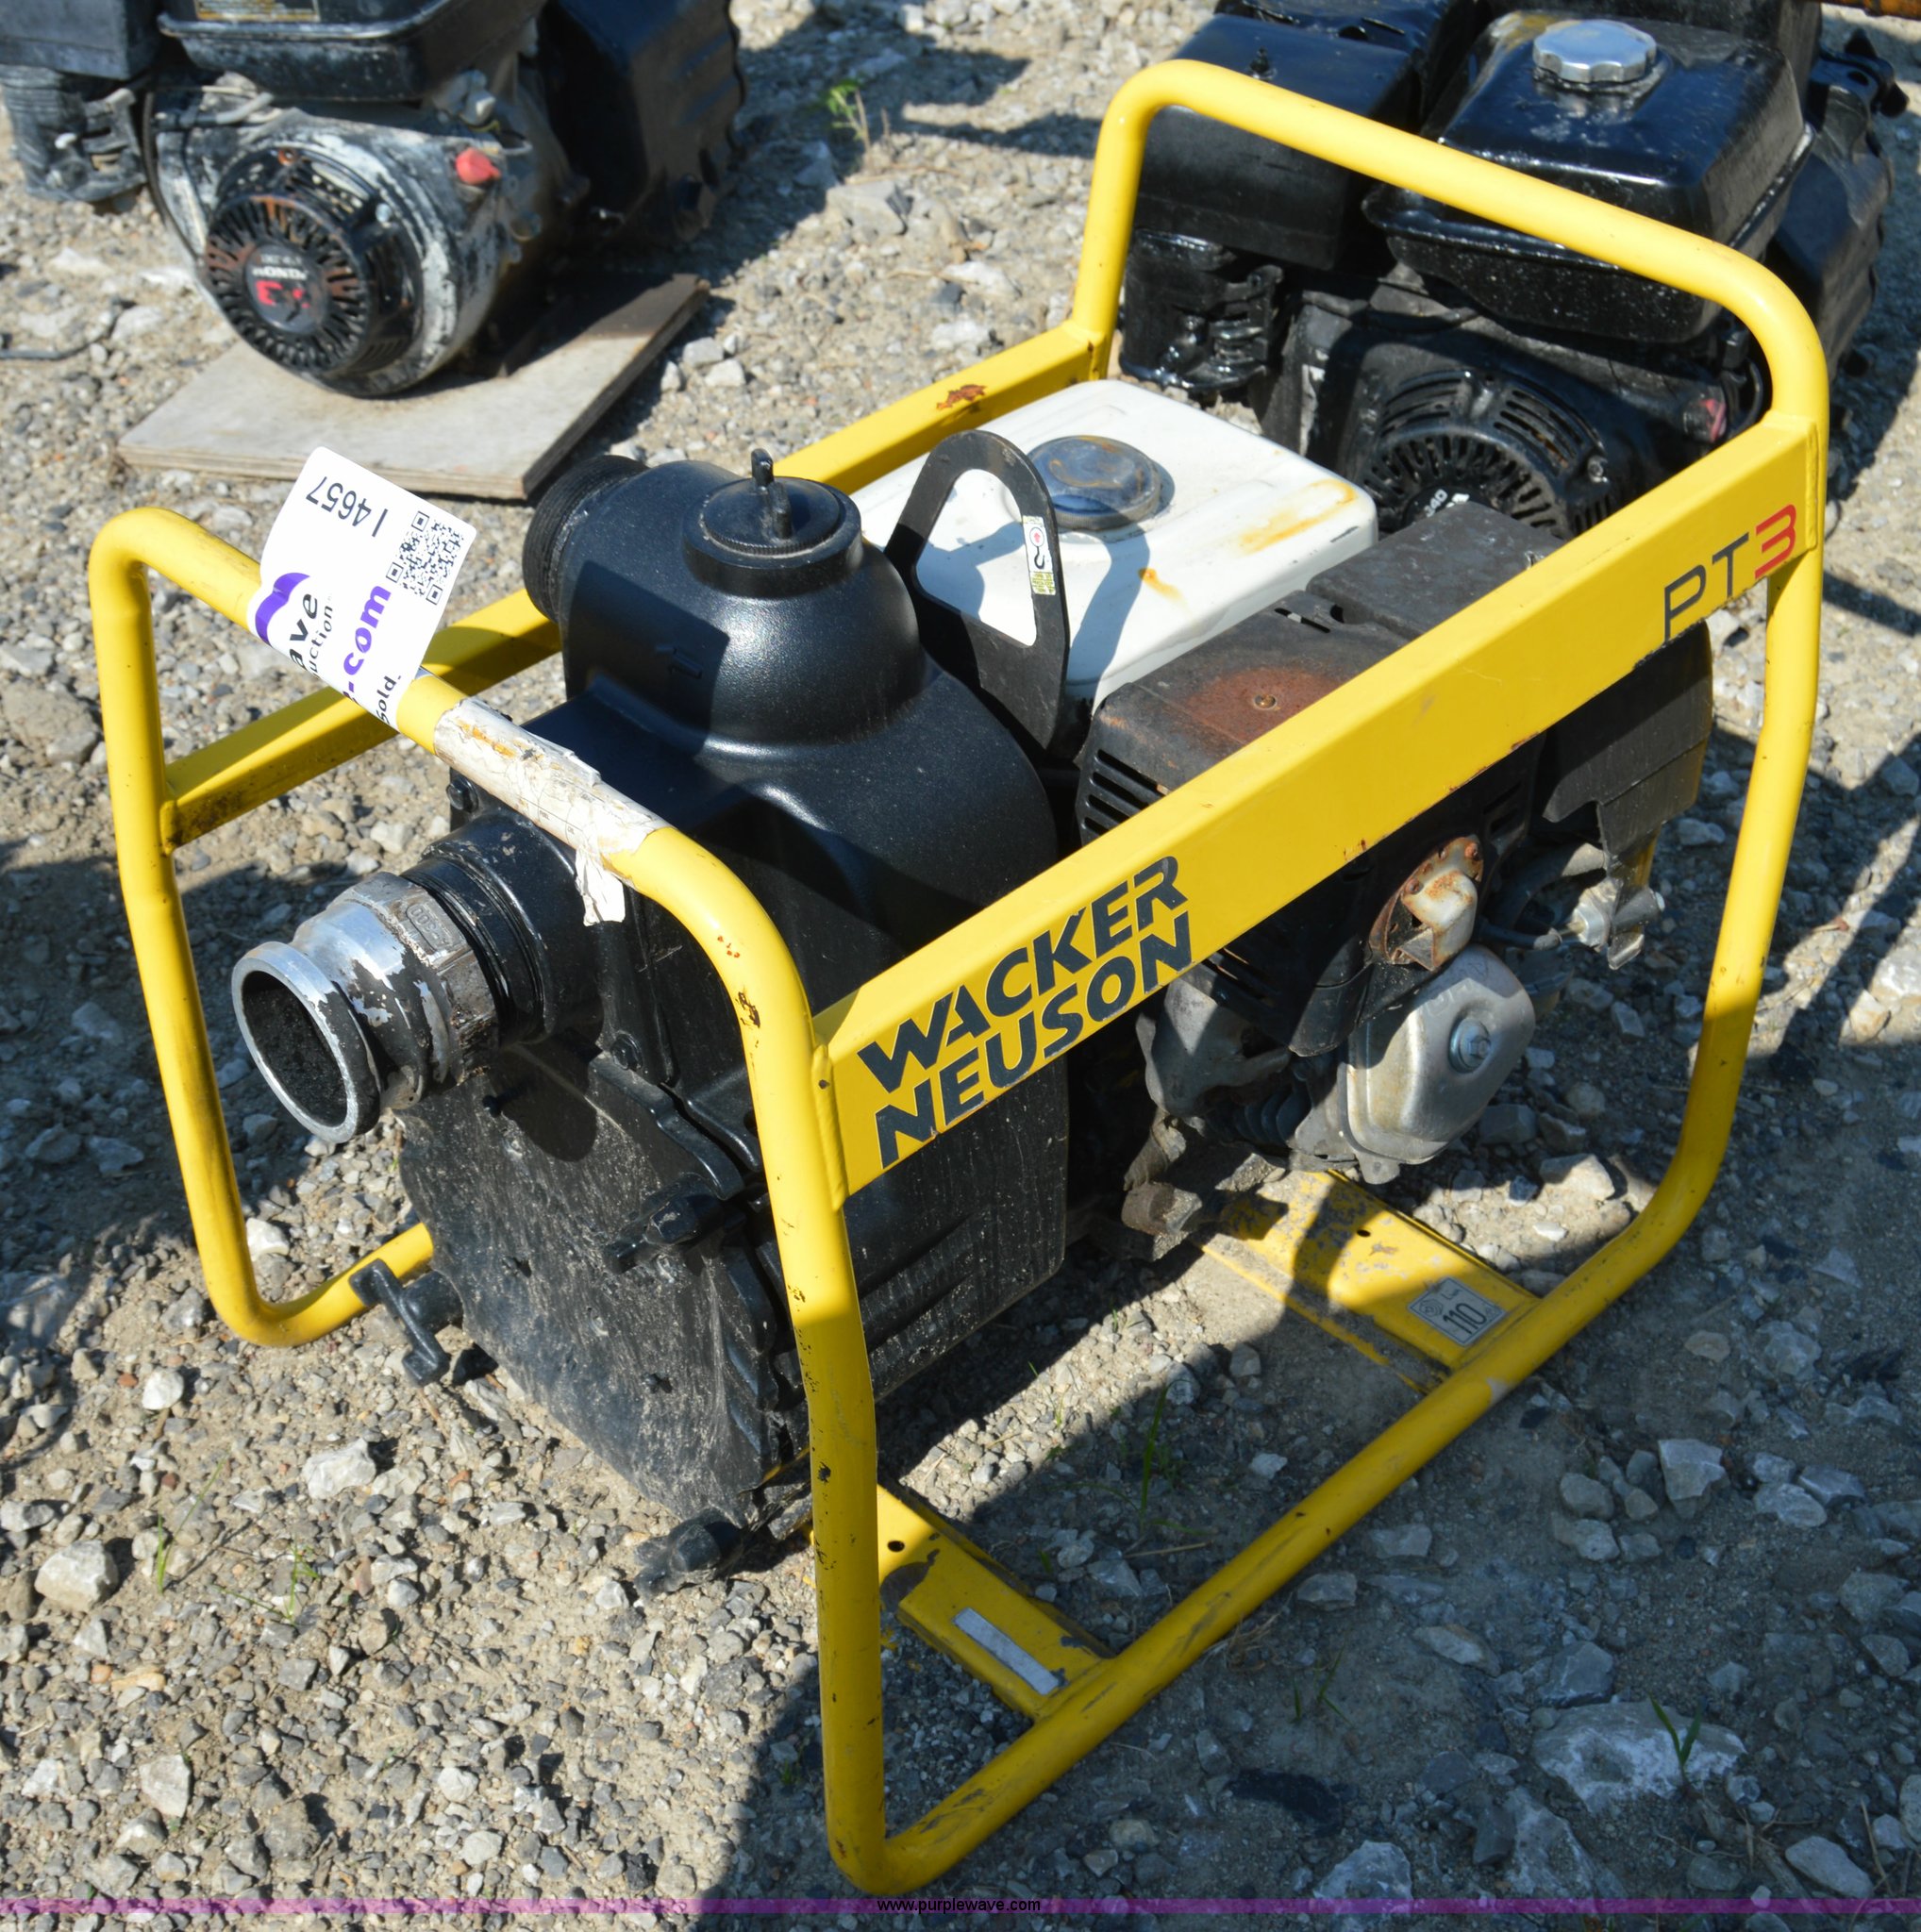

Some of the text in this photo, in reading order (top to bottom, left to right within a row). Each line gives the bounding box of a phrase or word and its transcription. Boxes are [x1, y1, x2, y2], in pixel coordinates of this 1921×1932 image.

[1664, 504, 1796, 643] PT3
[856, 856, 1188, 1094] WACKER
[875, 910, 1193, 1169] NEUSON
[1443, 1303, 1487, 1335] 110
